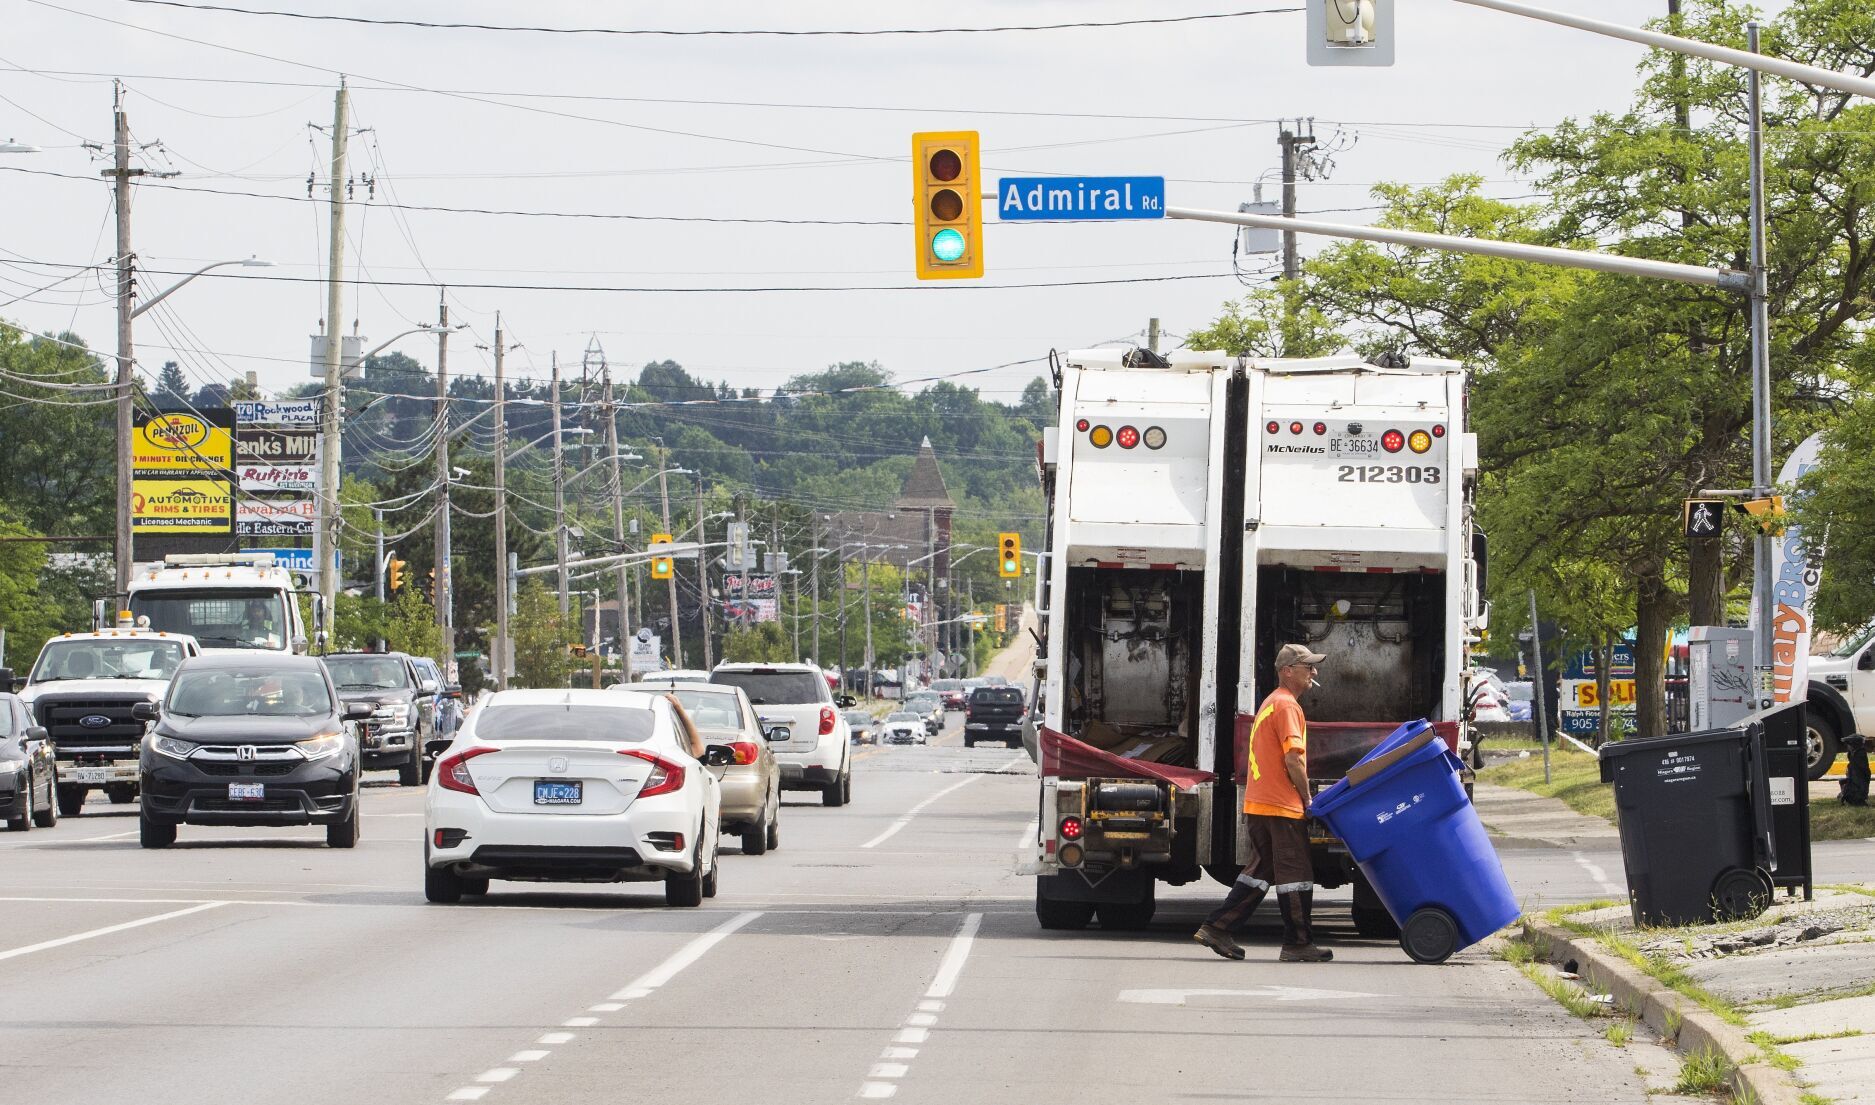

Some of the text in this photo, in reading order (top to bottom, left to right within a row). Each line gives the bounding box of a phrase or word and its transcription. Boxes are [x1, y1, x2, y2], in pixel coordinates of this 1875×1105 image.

[1003, 183, 1162, 211] Admiral Rd.
[255, 403, 313, 420] Rockwood
[153, 424, 200, 438] PENNZOIL
[237, 436, 282, 455] ank's
[1267, 445, 1325, 454] McNeilus
[139, 455, 172, 463] MINUTE
[175, 455, 188, 463] OIL
[241, 468, 309, 482] Ruffin's
[1338, 465, 1441, 484] 212303
[148, 496, 229, 504] AUTOMOTIVE
[153, 505, 180, 513] RIMS
[192, 505, 225, 513] TIRES
[236, 522, 314, 534] dle Eastern Cui
[1572, 718, 1592, 729] 905
[564, 787, 580, 799] 228
